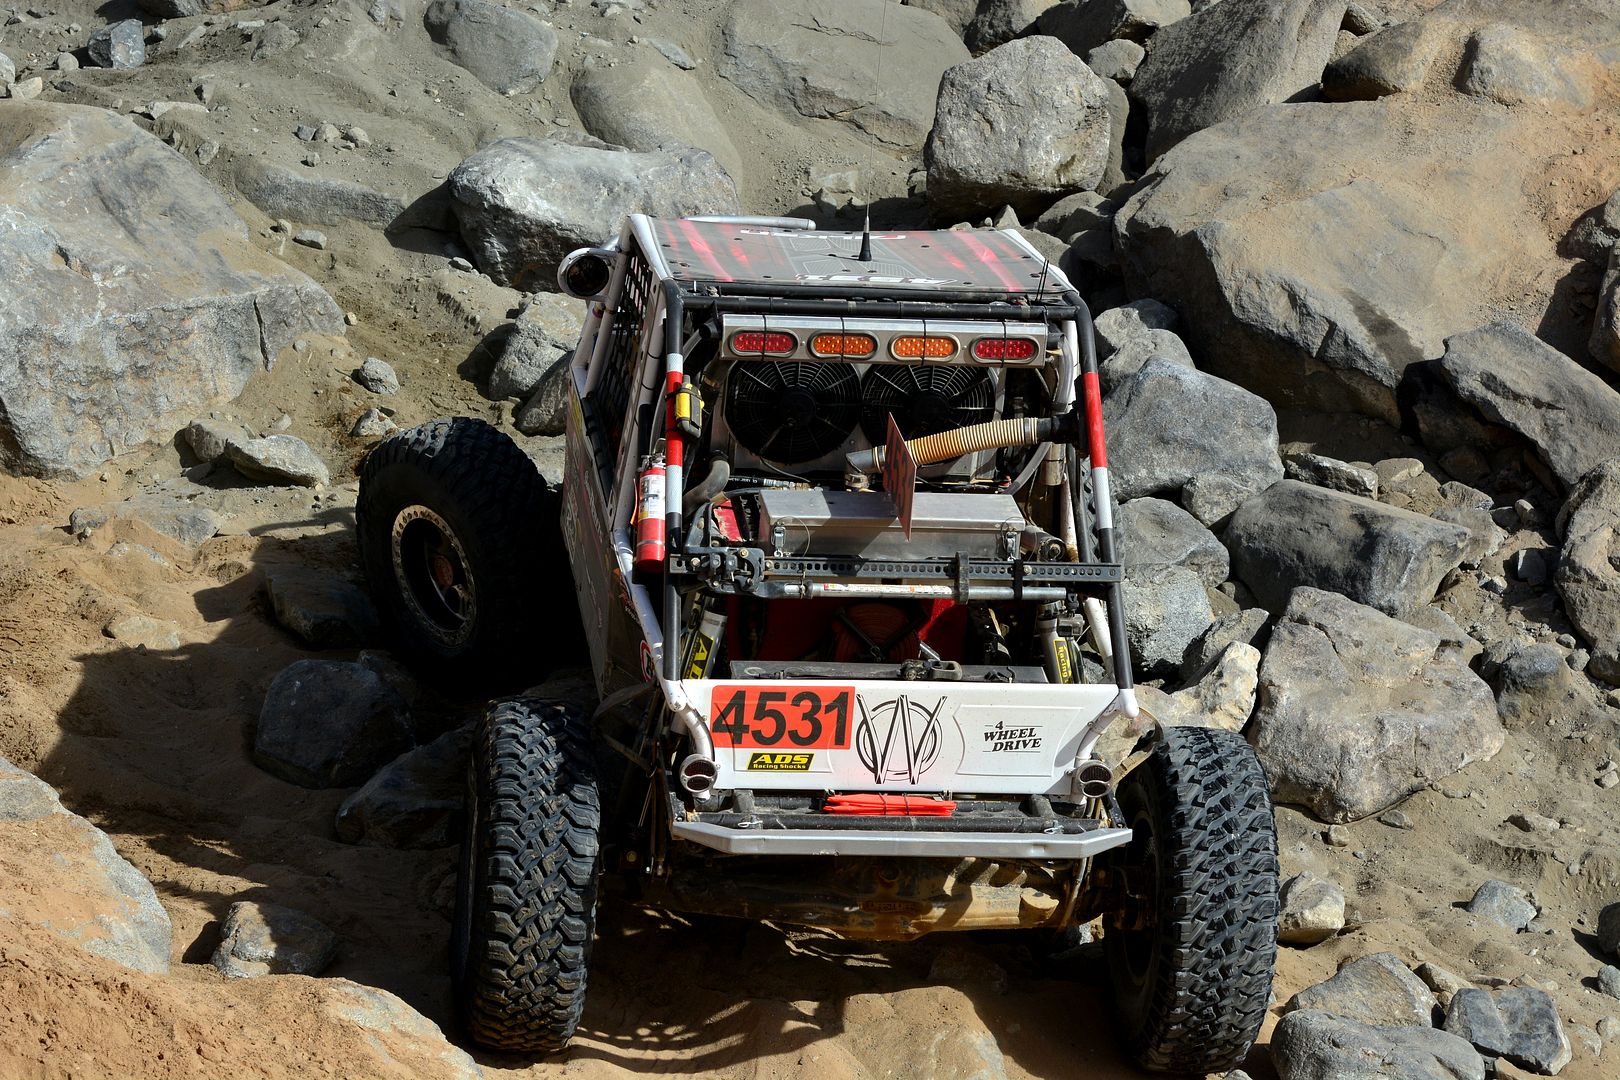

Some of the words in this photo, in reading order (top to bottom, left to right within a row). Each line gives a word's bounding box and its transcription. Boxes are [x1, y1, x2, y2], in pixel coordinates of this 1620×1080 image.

[712, 690, 849, 746] 4531
[995, 721, 1004, 730] 4
[984, 728, 1037, 741] WHEEL
[992, 738, 1042, 752] DRIVE
[753, 754, 810, 764] ADS
